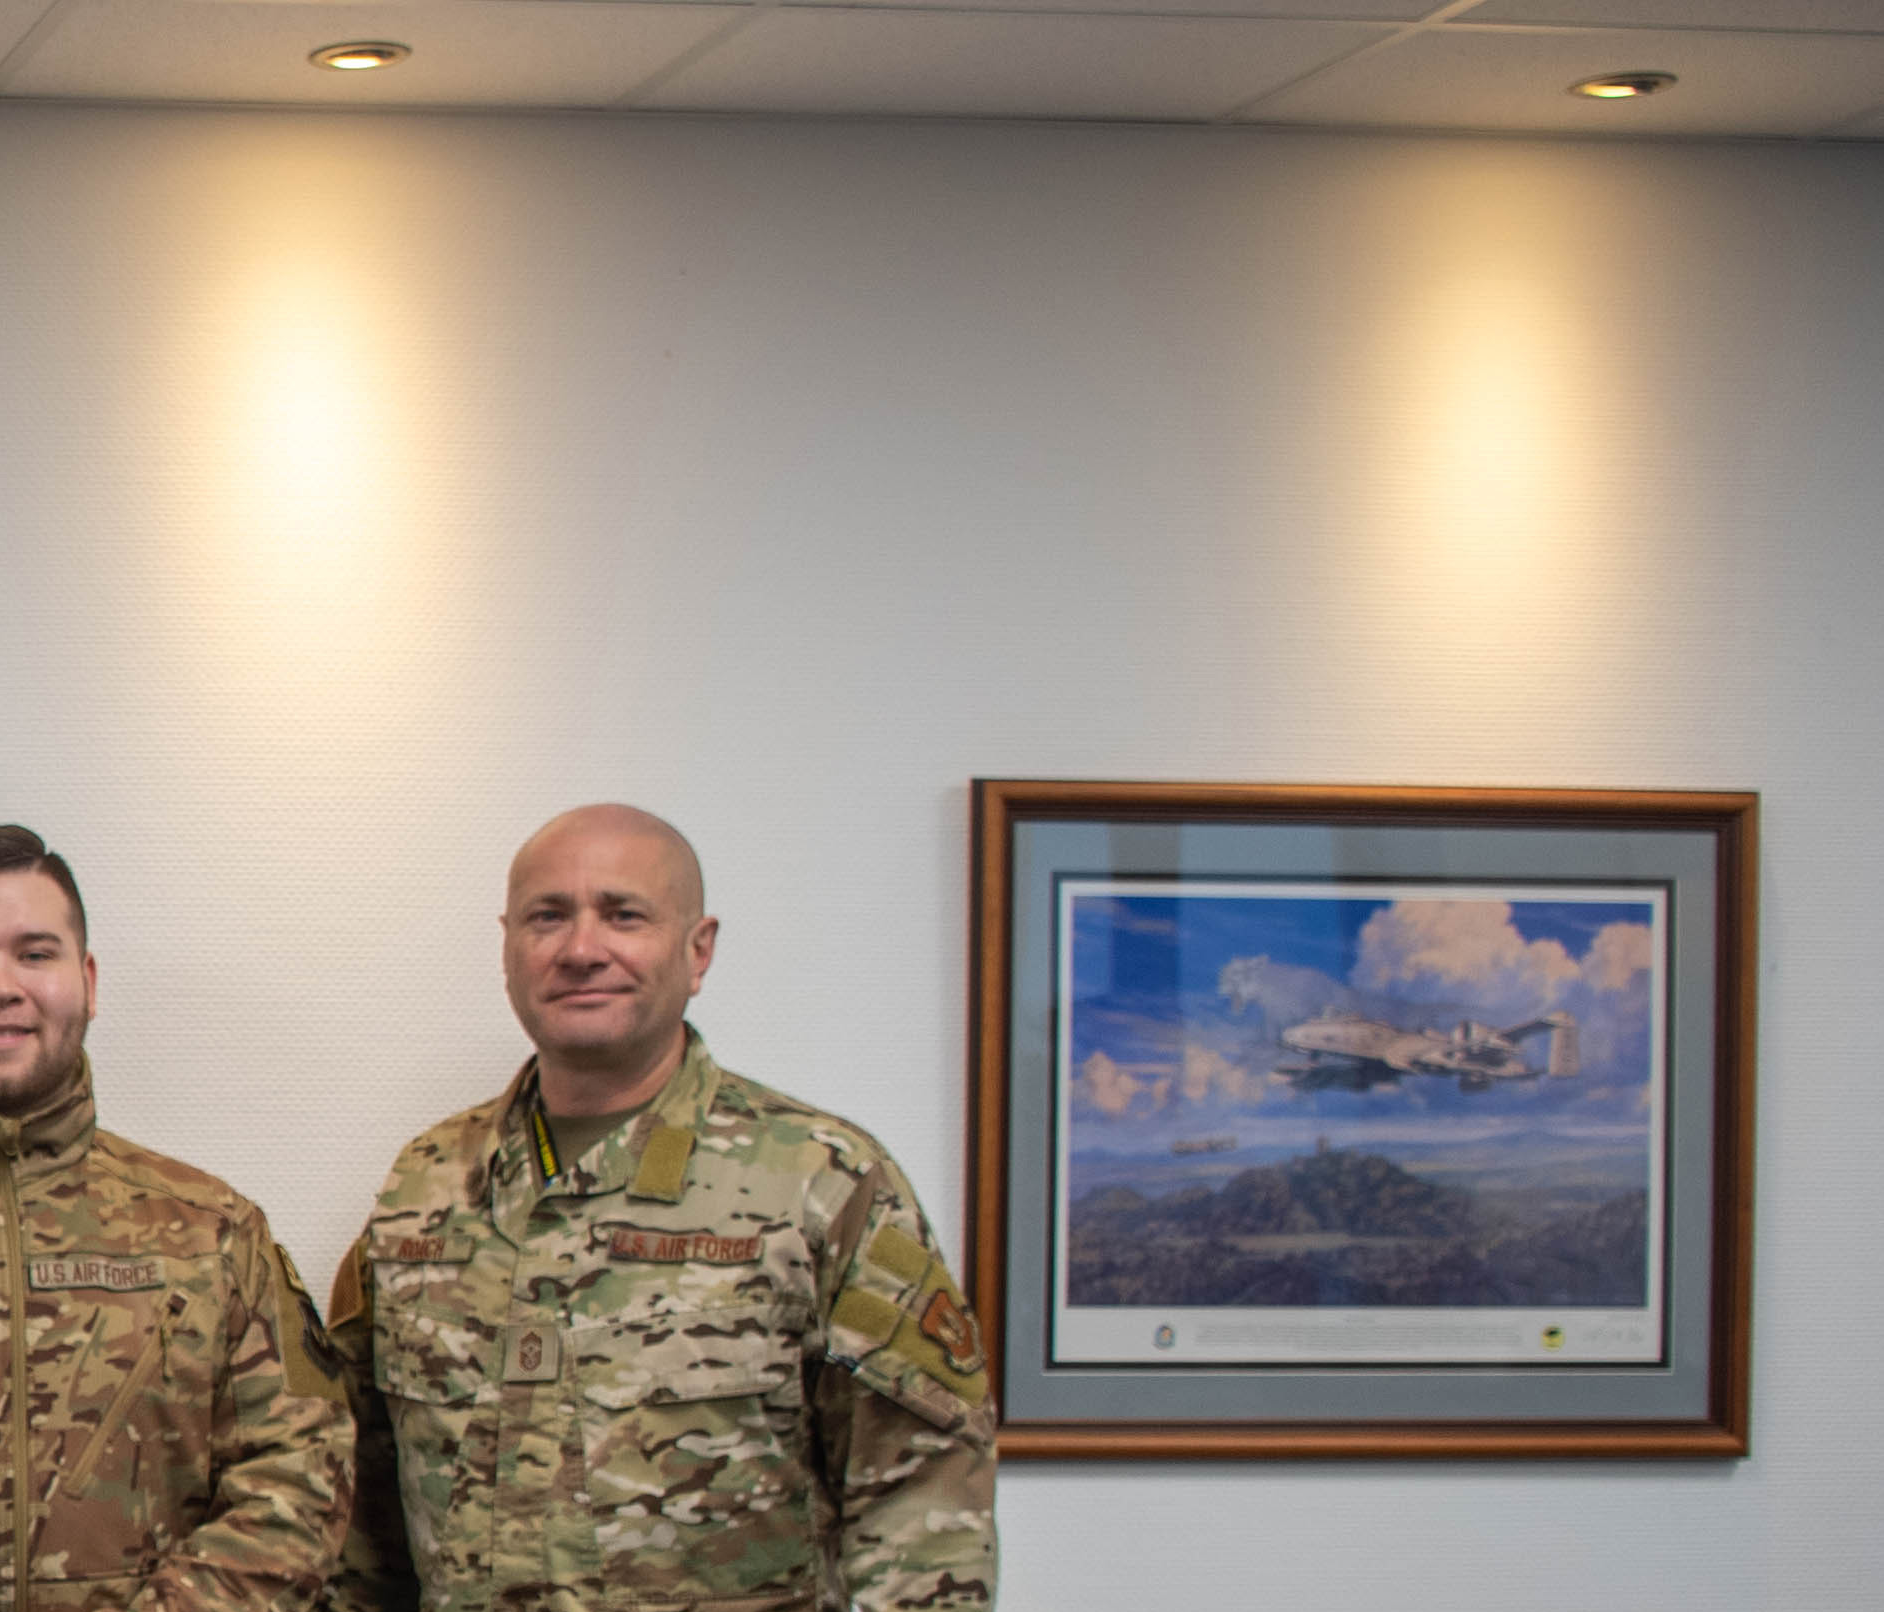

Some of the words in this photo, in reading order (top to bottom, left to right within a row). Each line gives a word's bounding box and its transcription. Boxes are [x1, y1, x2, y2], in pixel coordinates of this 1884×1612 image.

[655, 1237, 688, 1259] AIR
[692, 1235, 760, 1260] FORCE
[72, 1263, 100, 1283] AIR
[103, 1261, 157, 1287] FORCE
